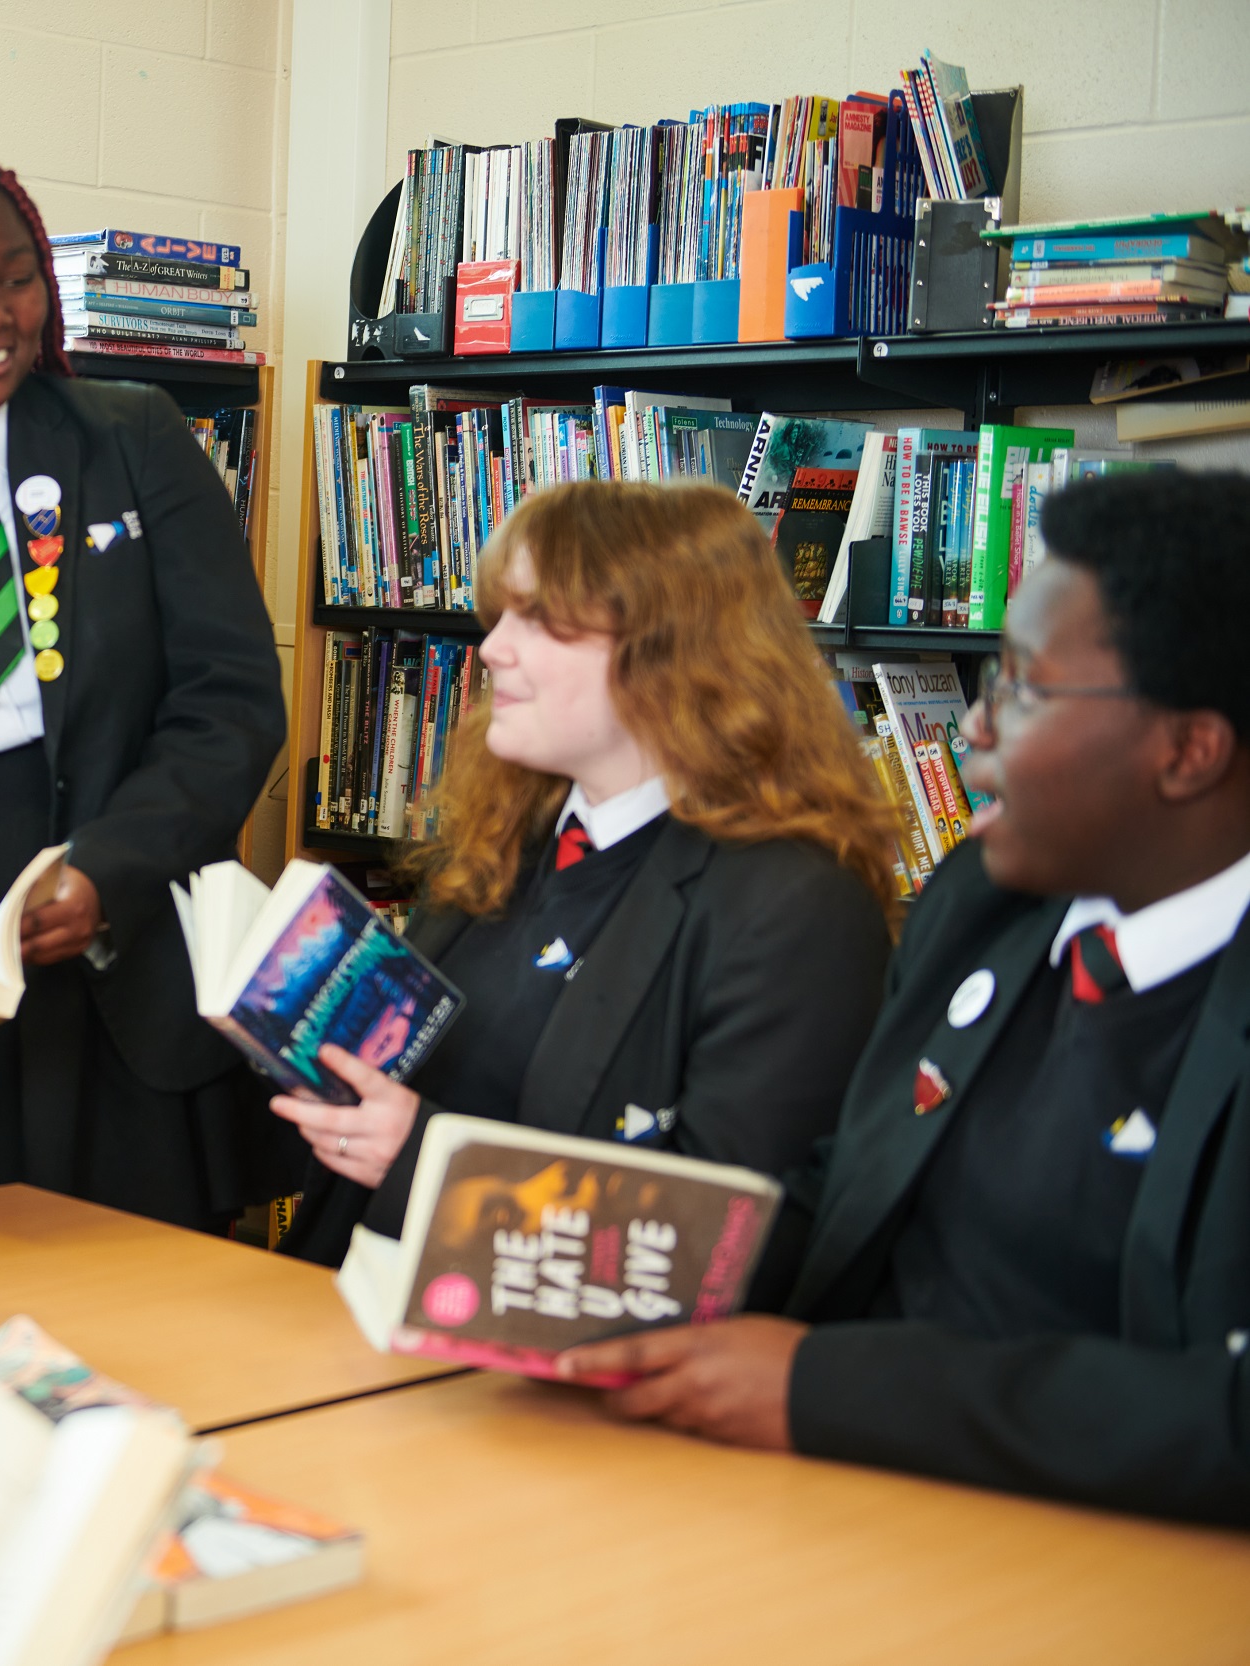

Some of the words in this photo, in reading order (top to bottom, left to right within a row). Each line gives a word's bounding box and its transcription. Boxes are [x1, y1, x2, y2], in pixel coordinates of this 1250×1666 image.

[844, 113, 870, 122] AMNESTY
[844, 122, 871, 132] MAGAZINE
[139, 235, 217, 261] ALIVE
[115, 259, 131, 271] The
[133, 263, 148, 272] A-Z
[149, 264, 158, 276] of
[157, 266, 185, 277] GREAT
[185, 269, 208, 280] Writers
[114, 280, 185, 300] HUMAN
[188, 288, 232, 305] BODY
[98, 314, 148, 330] SURVIVORS
[160, 306, 186, 316] ORBIT
[1058, 312, 1116, 328] INTELLIGENCE
[1119, 311, 1167, 324] ARTIFICIAL
[111, 329, 135, 337] BUILT
[99, 342, 115, 350] MOST
[183, 349, 204, 358] WORLD
[412, 422, 427, 448] The
[902, 437, 912, 460] HOW
[927, 443, 949, 452] HOW
[952, 444, 968, 453] TO
[978, 431, 991, 488] BILLIE
[405, 459, 415, 486] BRITISH
[414, 449, 426, 478] Wars
[901, 465, 910, 478] TO
[416, 479, 428, 494] of
[900, 482, 910, 495] BE
[913, 473, 922, 506] LOVES
[921, 473, 929, 497] THIS
[417, 495, 429, 510] the
[1027, 485, 1043, 528] dodie
[418, 511, 430, 544] Roses
[898, 509, 908, 545] BAWSE
[912, 509, 920, 532] YOU
[920, 501, 928, 532] BOOK
[974, 493, 988, 550] EILISH
[897, 550, 907, 573] LILLY
[910, 537, 924, 589] PEWDIEPIE
[887, 672, 916, 699] tony
[916, 670, 957, 693] buzan
[392, 699, 400, 721] WHEN
[878, 724, 890, 733] SH
[900, 711, 960, 757] Mind
[953, 740, 964, 748] SH
[386, 738, 396, 774] CHILDREN
[887, 750, 909, 793] GOGGINS
[922, 770, 933, 789] YOUR
[938, 771, 950, 790] YOUR
[927, 788, 941, 811] HEAD
[943, 790, 957, 813] HEAD
[912, 790, 929, 834] INTRODUCTION
[909, 828, 926, 854] HURT
[918, 855, 930, 871] ME
[491, 1227, 542, 1316] THE
[534, 1204, 590, 1320] HATE
[624, 1218, 682, 1321] GIVE
[578, 1283, 625, 1319] U
